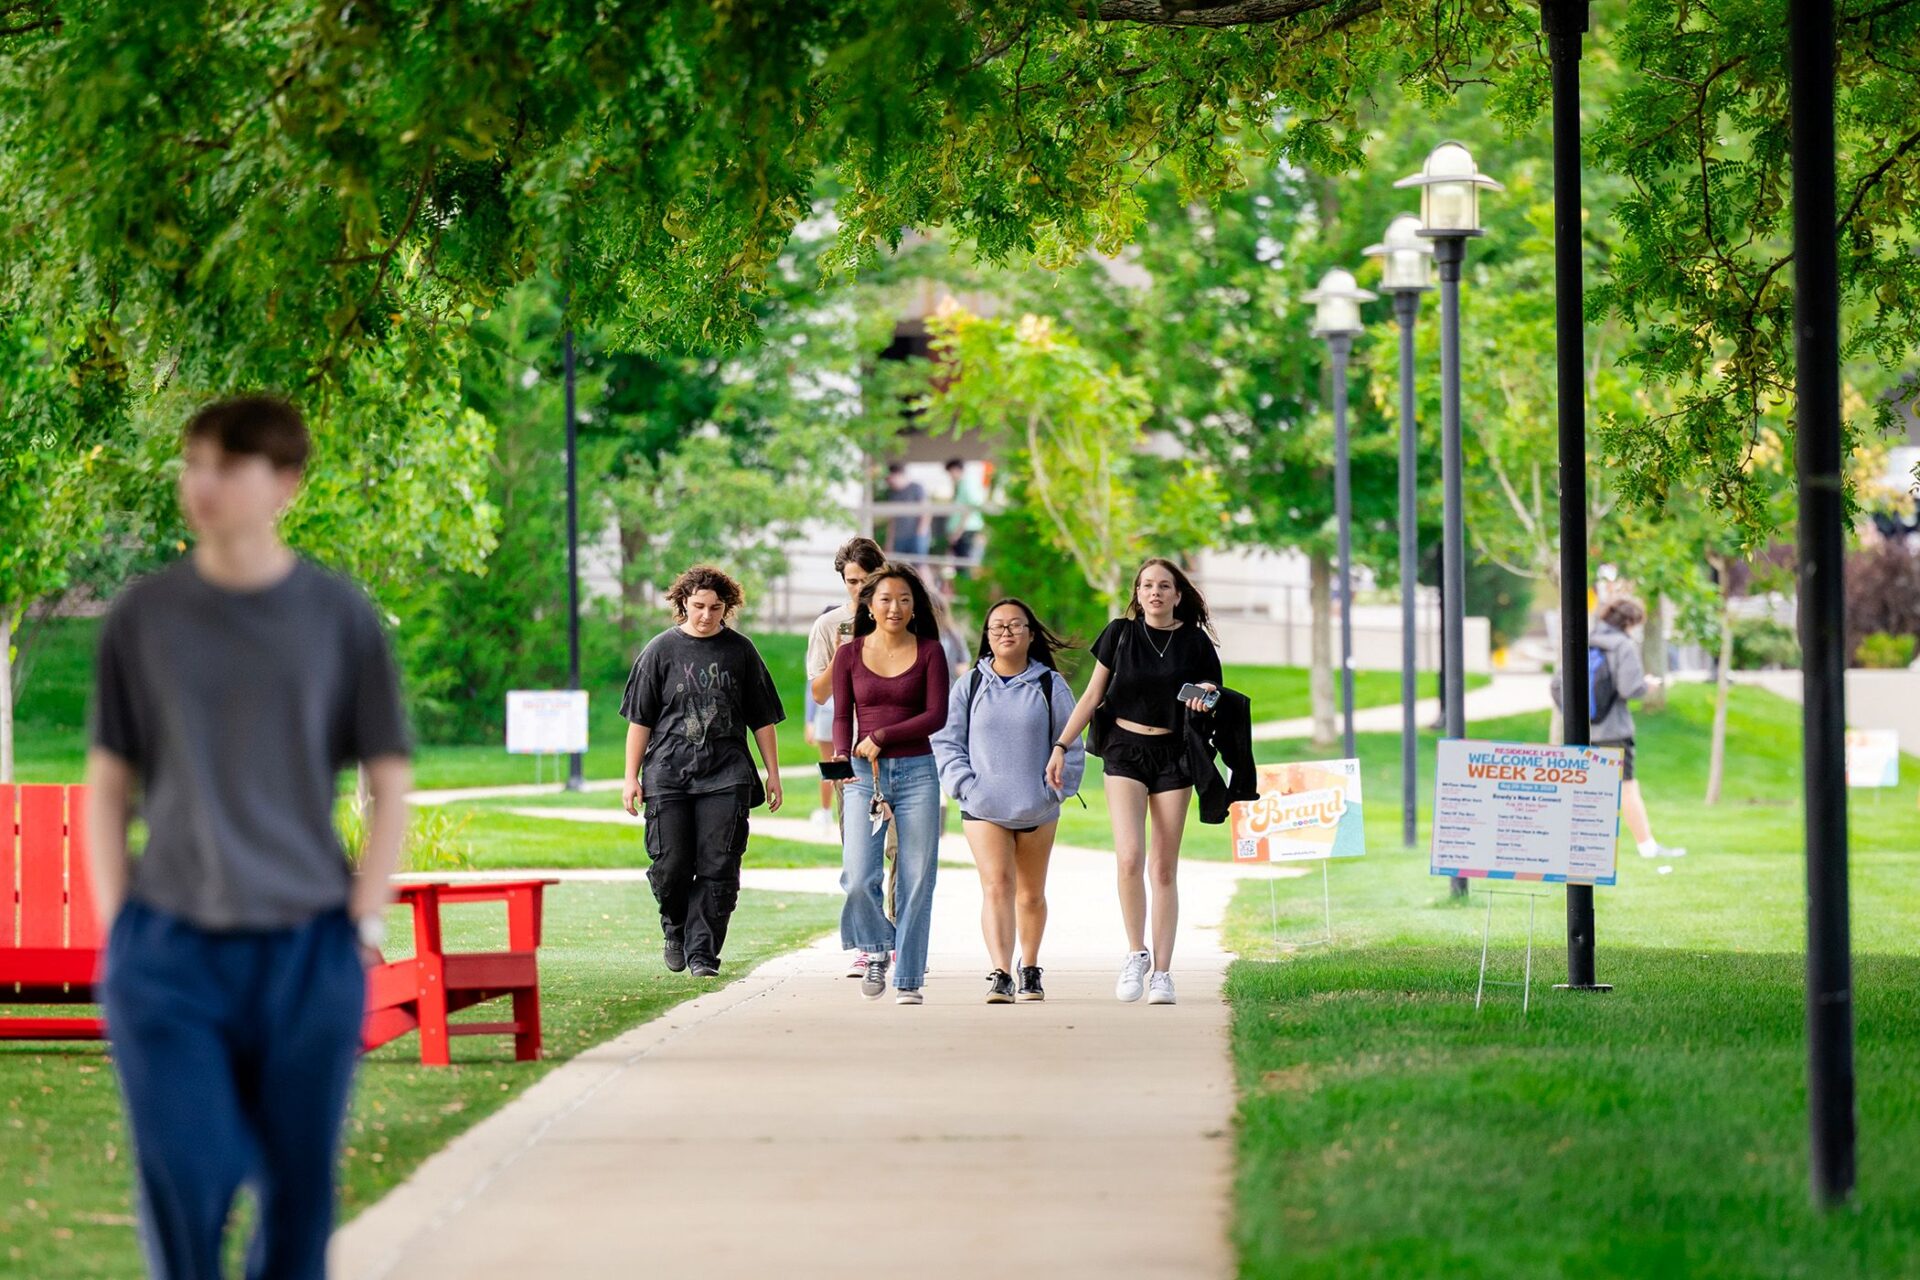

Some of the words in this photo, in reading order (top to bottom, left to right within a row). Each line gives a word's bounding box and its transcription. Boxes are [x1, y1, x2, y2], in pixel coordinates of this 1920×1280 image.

[1494, 748, 1538, 756] RESIDENCE
[1468, 753, 1543, 767] WELCOME
[1547, 757, 1590, 770] HOME
[1468, 764, 1526, 781] WEEK
[1533, 768, 1588, 784] 2025
[1250, 789, 1342, 833] Brand
